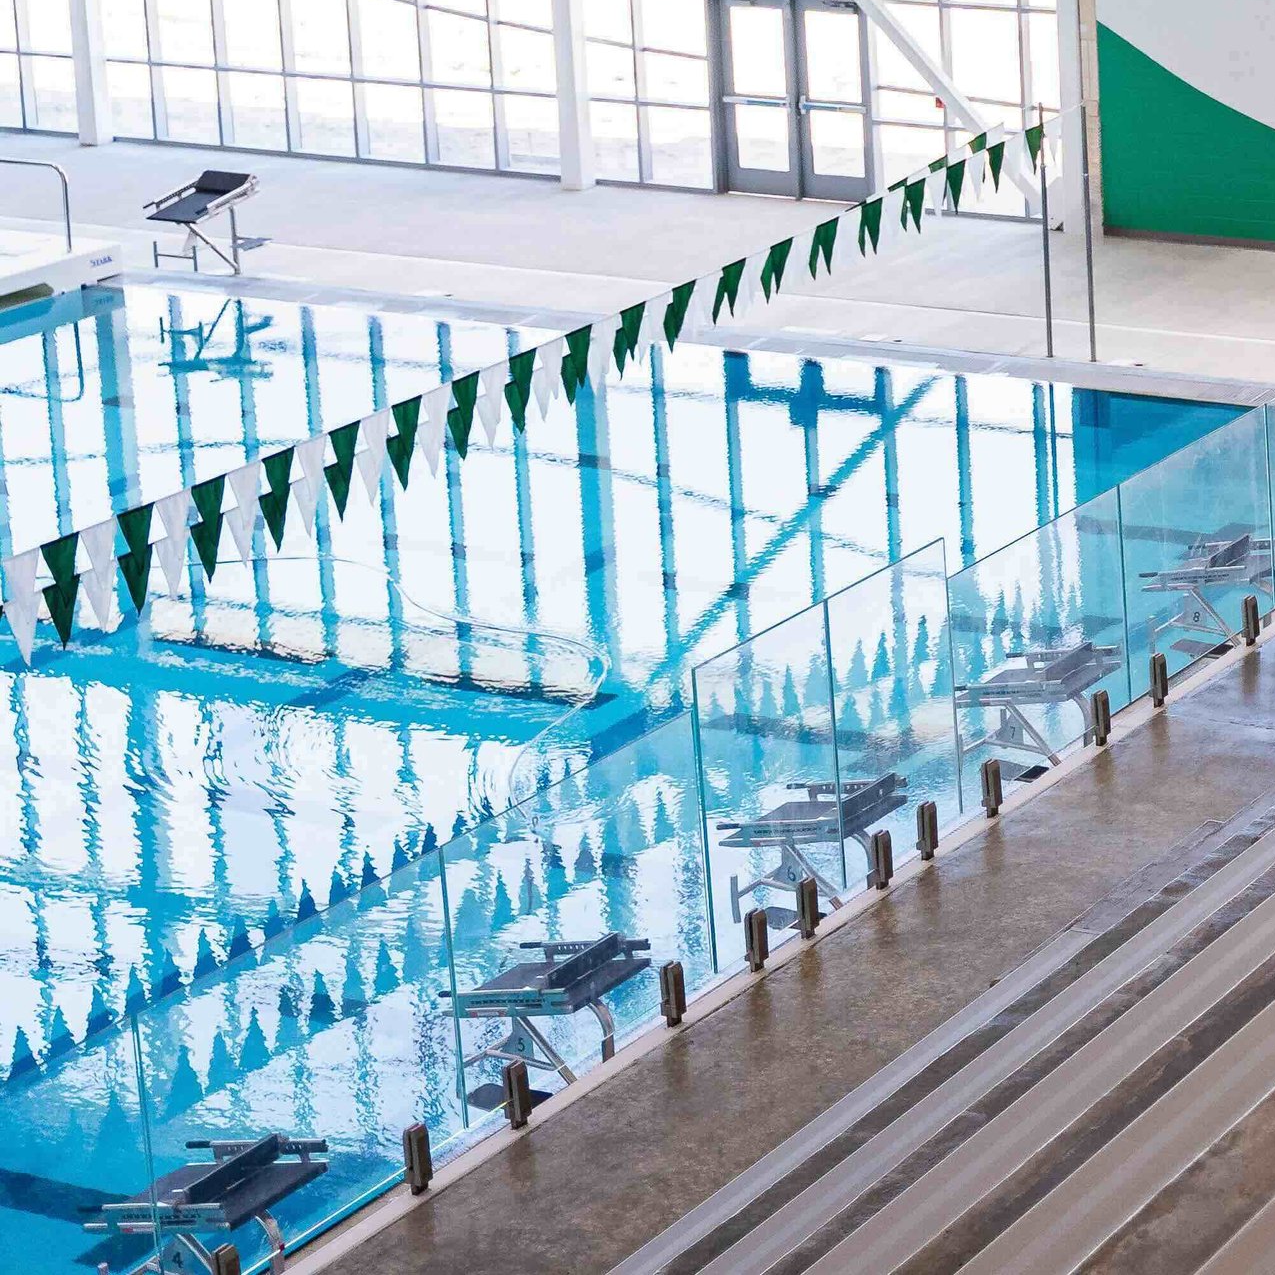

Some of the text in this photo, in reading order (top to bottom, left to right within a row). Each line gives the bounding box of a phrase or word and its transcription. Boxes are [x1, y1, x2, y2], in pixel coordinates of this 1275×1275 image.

[1193, 611, 1201, 622] 8
[1010, 726, 1016, 739] 7
[786, 866, 796, 882] 6
[517, 1036, 526, 1052] 5
[172, 1251, 184, 1268] 4
